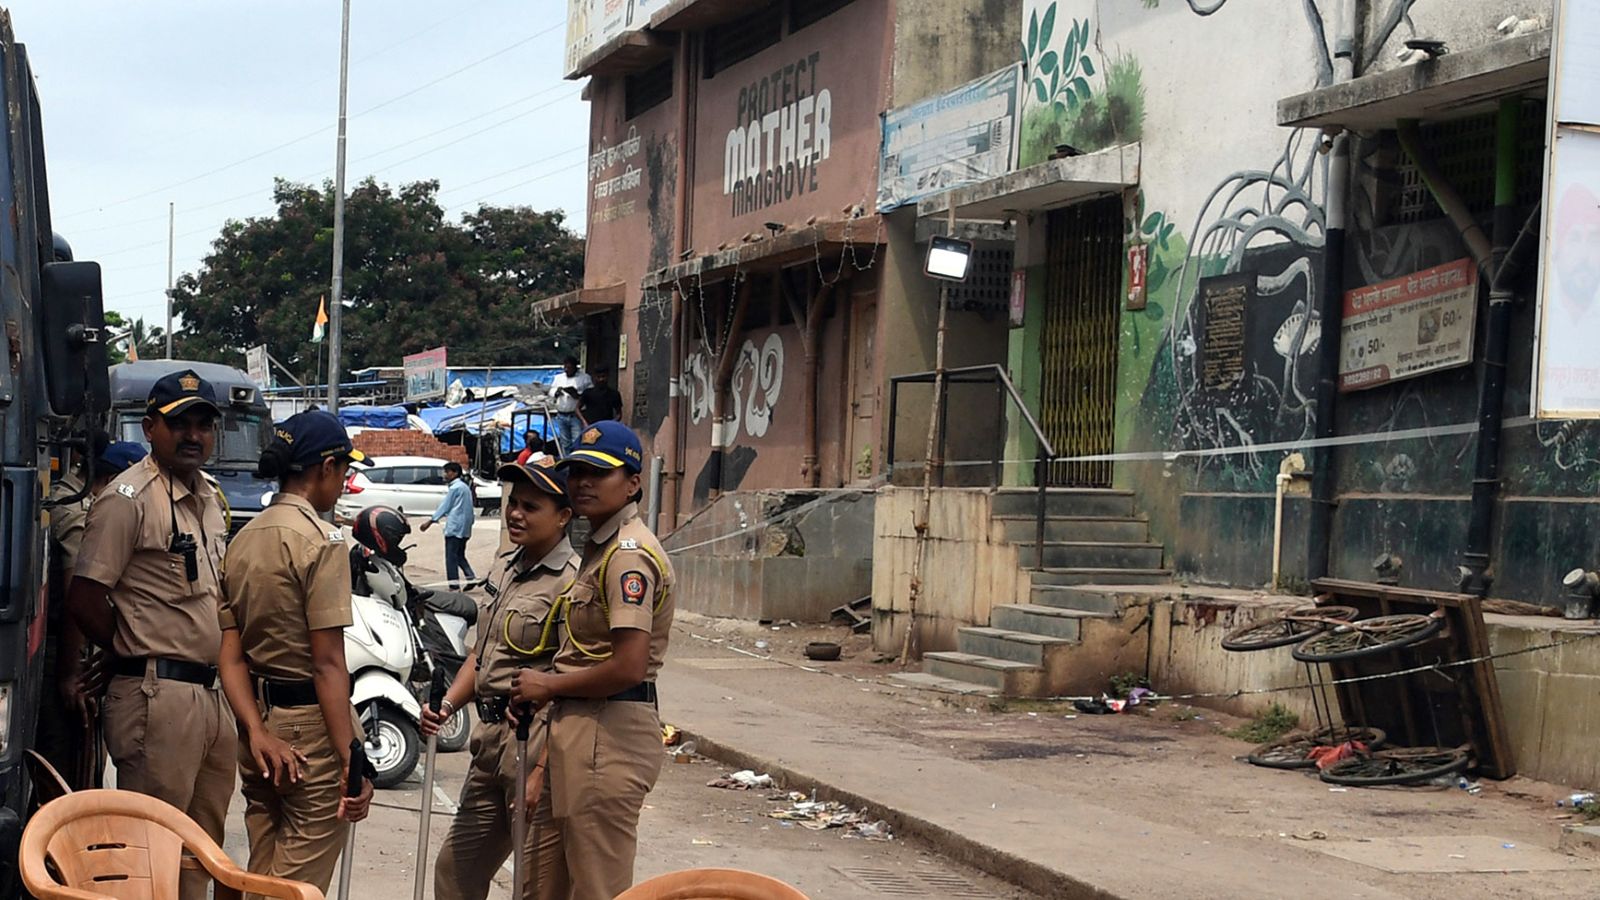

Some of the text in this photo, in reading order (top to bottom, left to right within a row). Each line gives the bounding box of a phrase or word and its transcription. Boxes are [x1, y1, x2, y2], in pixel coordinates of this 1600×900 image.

[737, 51, 820, 126] PROTECT
[723, 88, 832, 195] MOTHER
[732, 152, 821, 219] MANGROVE
